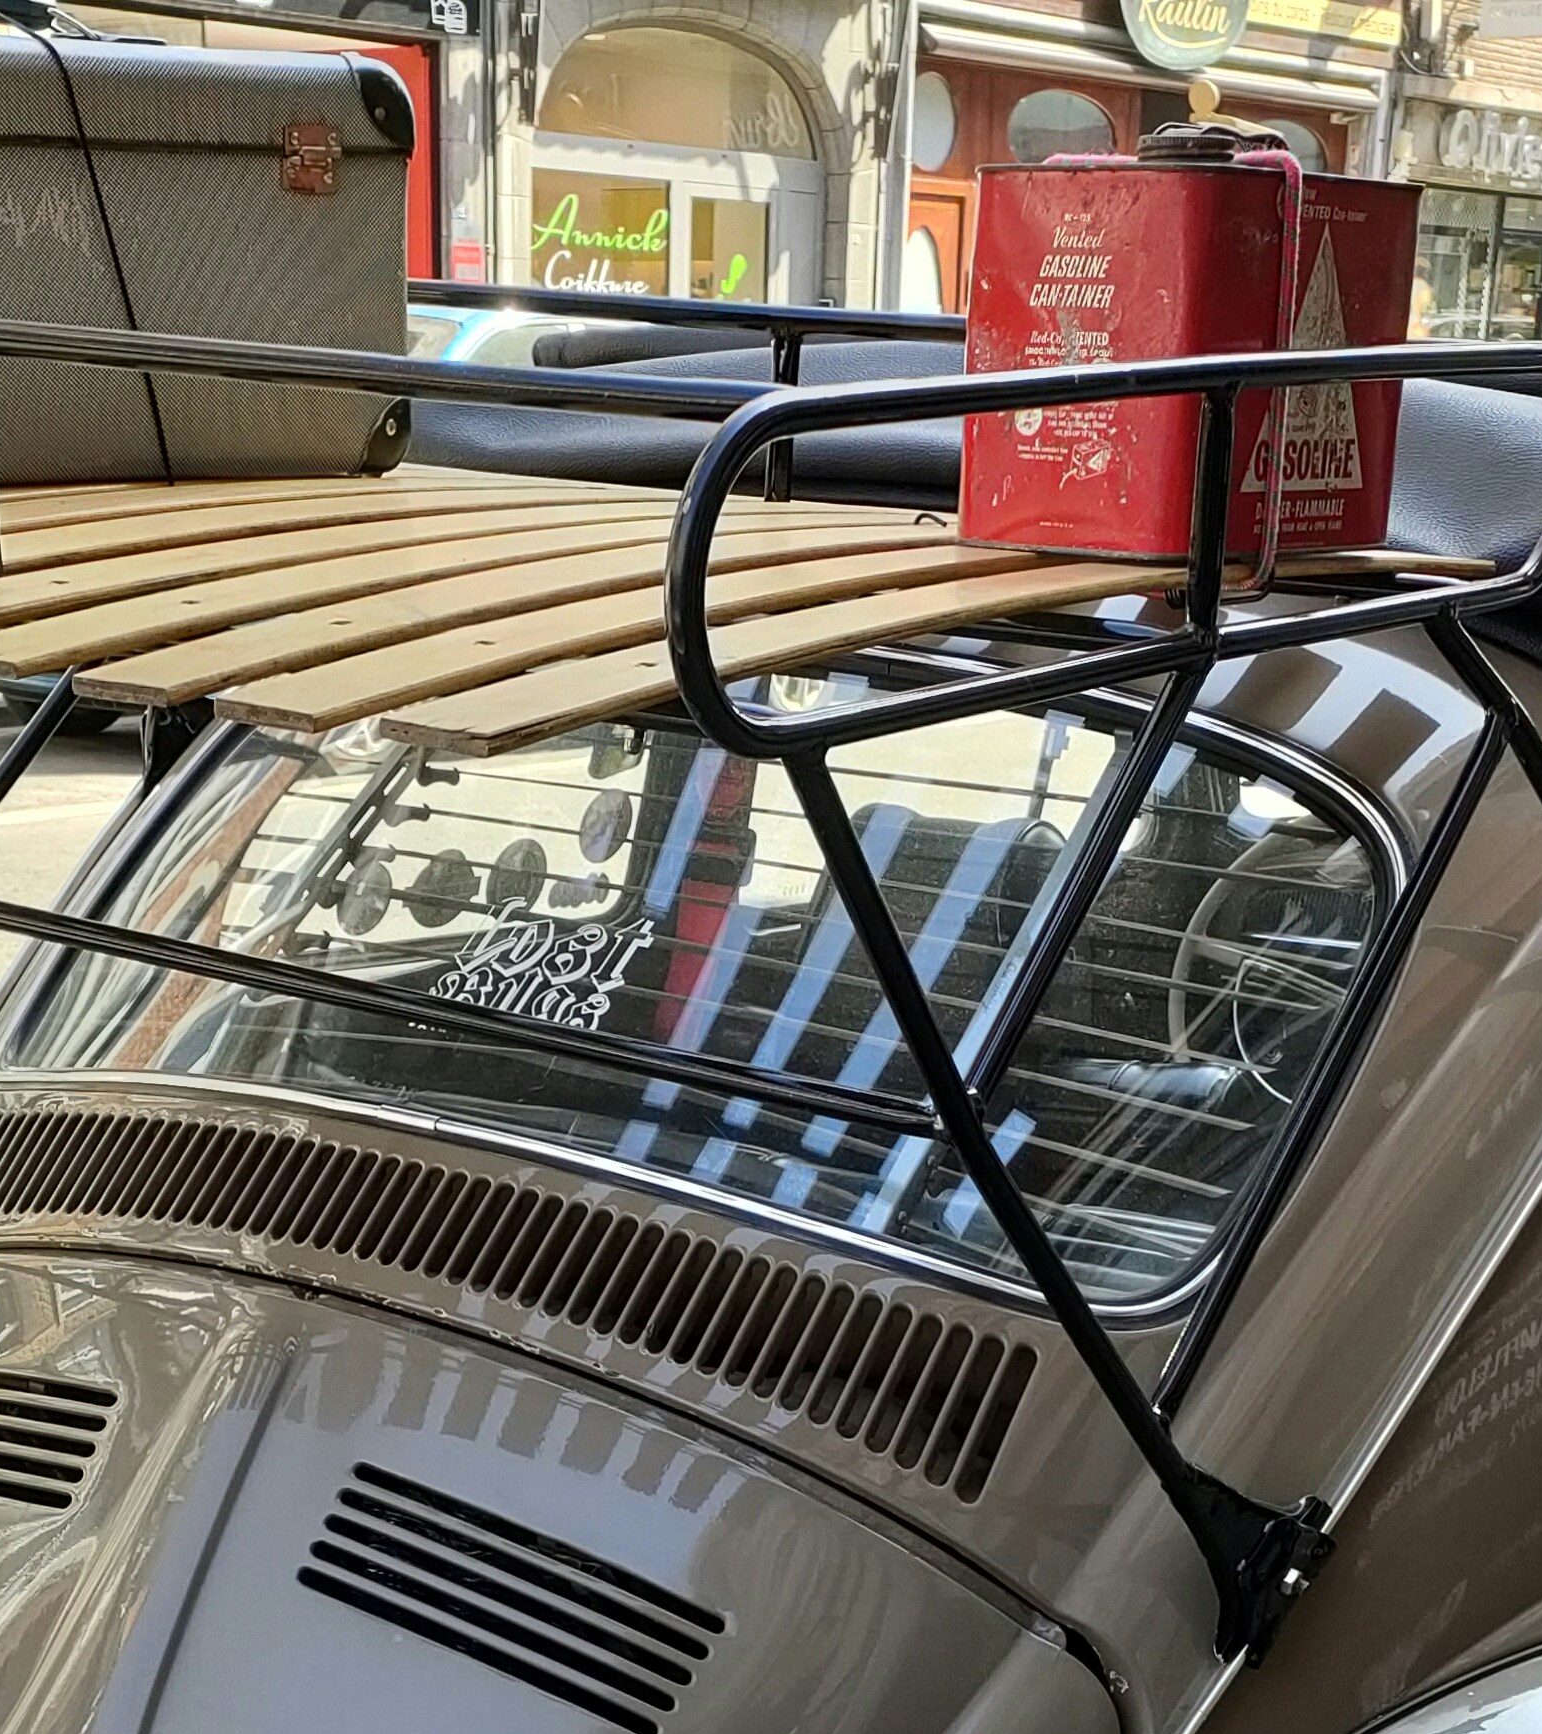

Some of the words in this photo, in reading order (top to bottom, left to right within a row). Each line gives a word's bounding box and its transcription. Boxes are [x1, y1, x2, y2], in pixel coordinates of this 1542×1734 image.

[530, 193, 668, 251] Annick
[1052, 226, 1106, 249] Vented
[1039, 255, 1113, 278] GASOLINE
[1254, 438, 1356, 482] GSOLINE
